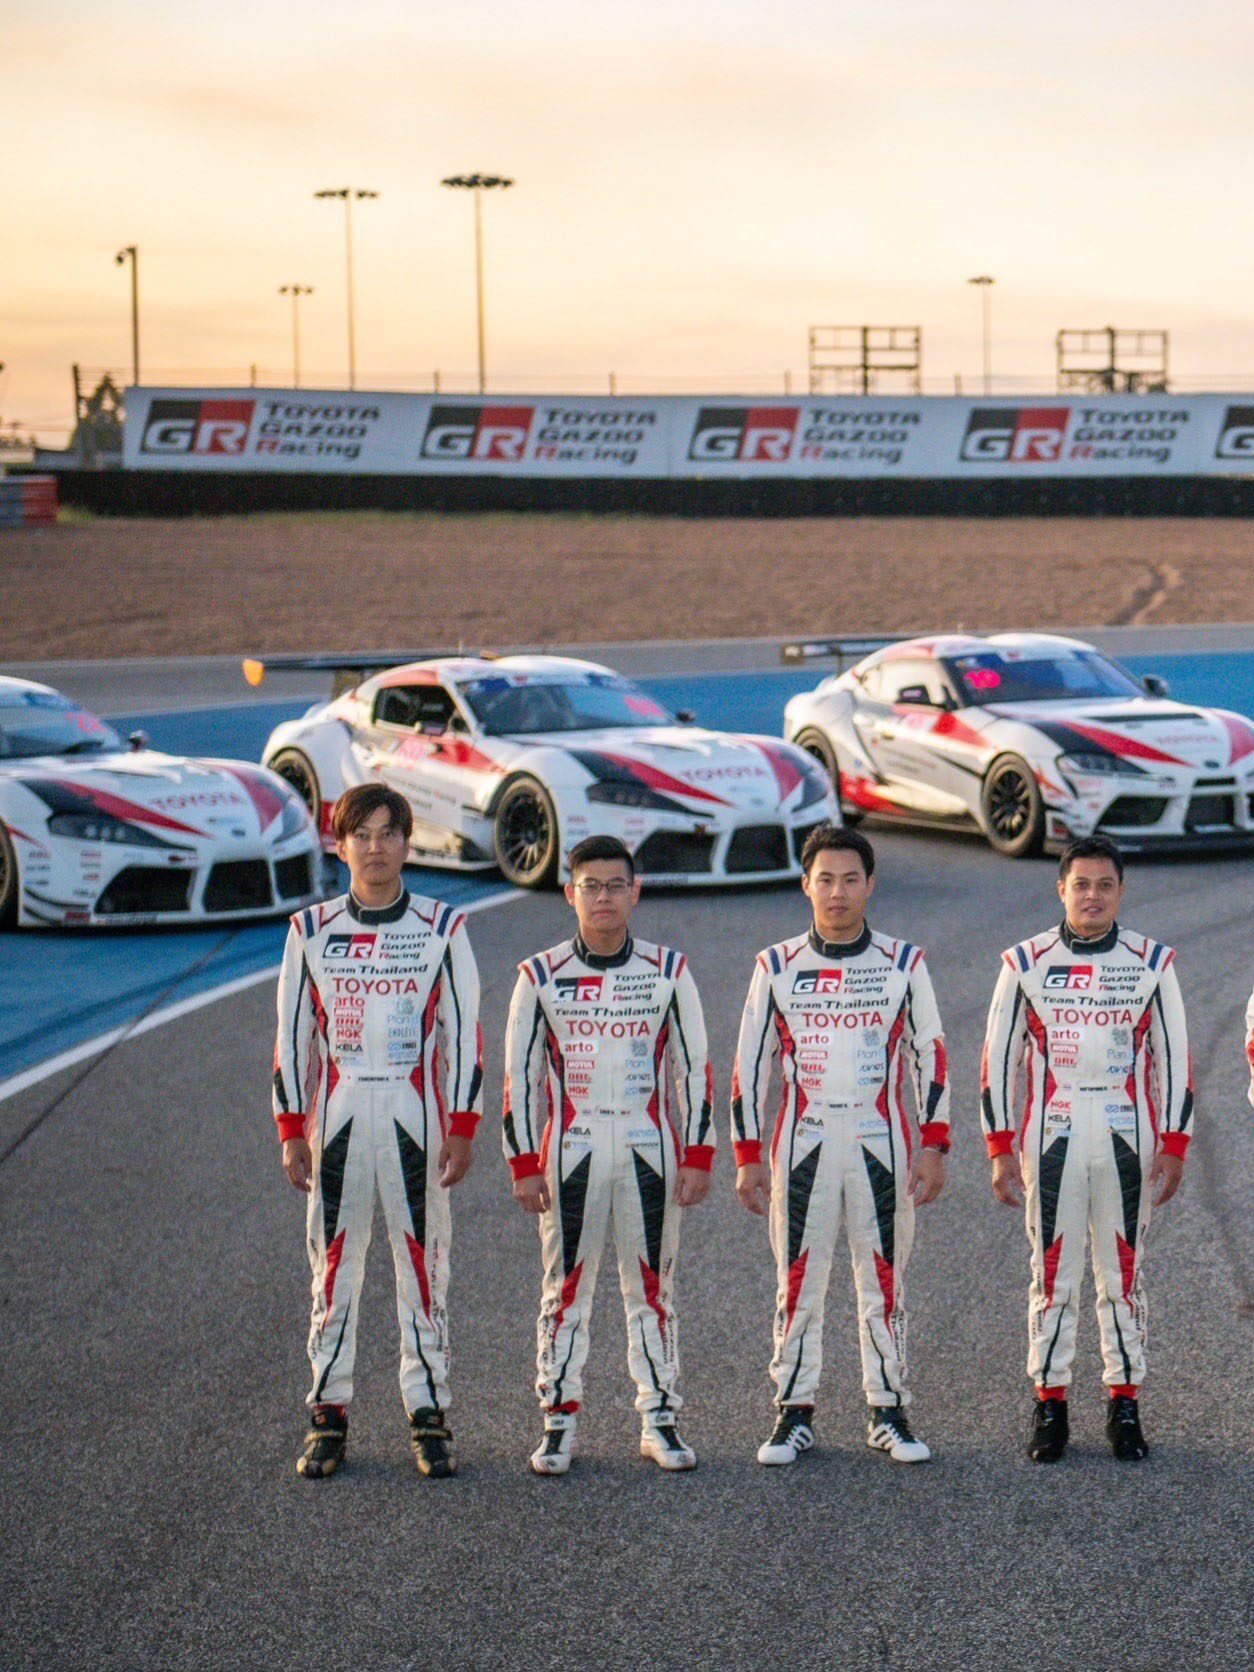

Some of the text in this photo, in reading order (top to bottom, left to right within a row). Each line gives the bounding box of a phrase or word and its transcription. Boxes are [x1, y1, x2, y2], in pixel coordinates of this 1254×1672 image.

[266, 402, 381, 421] TOYOTA
[543, 408, 657, 426] TOYOTA
[806, 408, 922, 425] TOYOTA
[1076, 408, 1191, 425] TOYOTA
[143, 416, 250, 455] GR
[259, 421, 367, 437] GAZOO
[538, 428, 644, 443] GAZOO
[803, 428, 909, 443] GAZOO
[1073, 428, 1178, 443] GAZOO
[422, 422, 527, 459] GR
[690, 425, 793, 461] GR
[961, 426, 1065, 461] GR
[256, 440, 362, 459] Racing
[533, 446, 637, 465] Racing
[800, 446, 902, 464] Racing
[1070, 445, 1172, 463] Racing
[382, 931, 432, 941] TOYOTA
[323, 940, 374, 959] GR
[380, 941, 426, 950] GAZOO
[378, 952, 421, 961] Racing
[322, 963, 429, 976] Team Thailand
[846, 966, 892, 975] TOYOTA
[1100, 965, 1146, 973] TOYOTA
[613, 972, 661, 982] TOYOTA
[844, 976, 887, 985] GAZOO
[1044, 972, 1091, 989] GR
[1099, 975, 1141, 983] GAZOO
[332, 977, 419, 995] TOYOTA
[612, 982, 657, 992] GAZOO
[793, 976, 841, 994] GR
[843, 985, 884, 994] Racing
[1099, 984, 1136, 992] Racing
[334, 995, 366, 1007] arto
[612, 992, 653, 1002] Racing
[789, 998, 890, 1010] Team Thailand
[1042, 996, 1144, 1006] Team Thailand
[554, 1005, 661, 1017] Team Thailand
[1052, 1008, 1133, 1026] TOYOTA
[802, 1011, 883, 1029] TOYOTA
[566, 1020, 651, 1038] TOYOTA
[1052, 1029, 1080, 1039] arto
[800, 1034, 829, 1044] arto
[336, 1044, 363, 1052] KELA
[565, 1042, 594, 1052] arto
